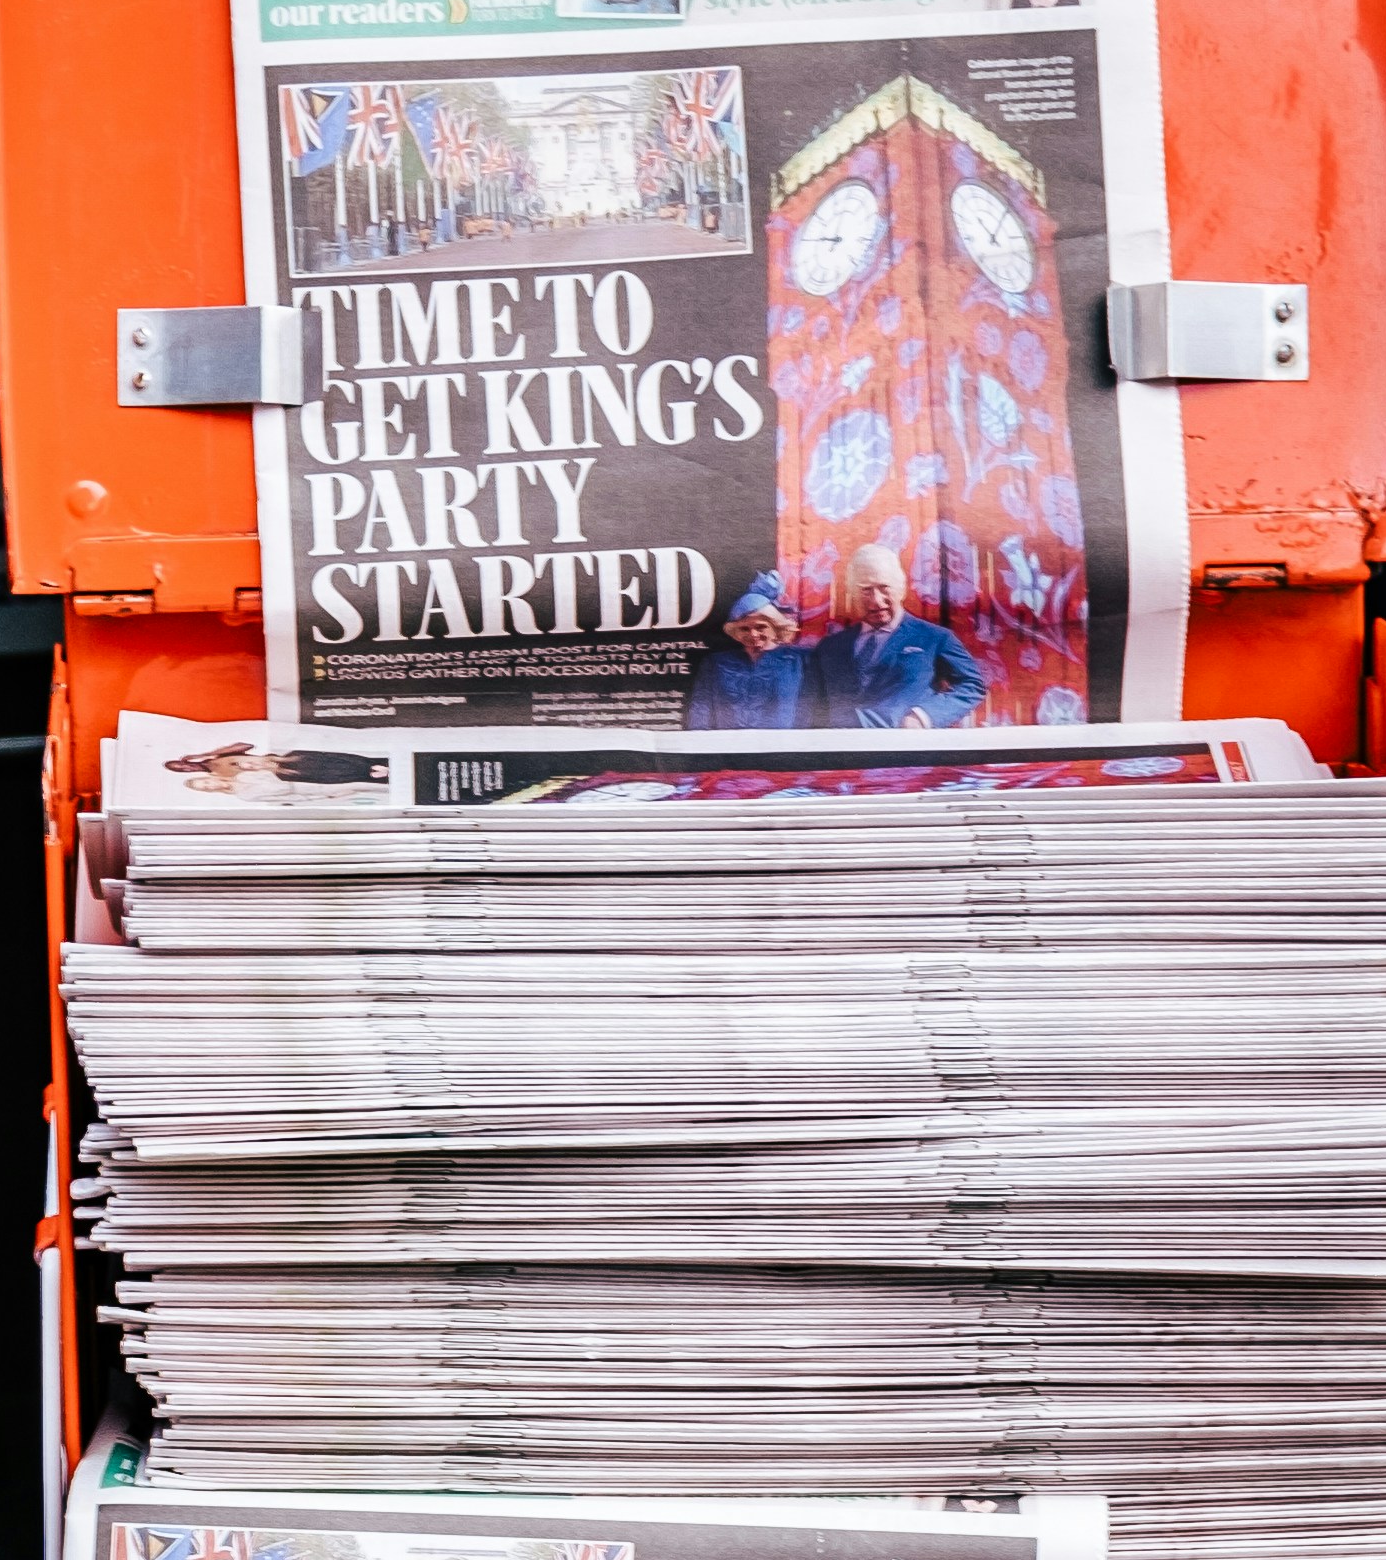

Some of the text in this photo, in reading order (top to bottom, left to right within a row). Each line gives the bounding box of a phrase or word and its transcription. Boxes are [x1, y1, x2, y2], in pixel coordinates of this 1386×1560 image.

[268, 4, 324, 28] our
[293, 269, 654, 372] TIME TO
[300, 370, 467, 466] GET
[305, 457, 597, 558] PARTY
[311, 545, 715, 644] STARTED
